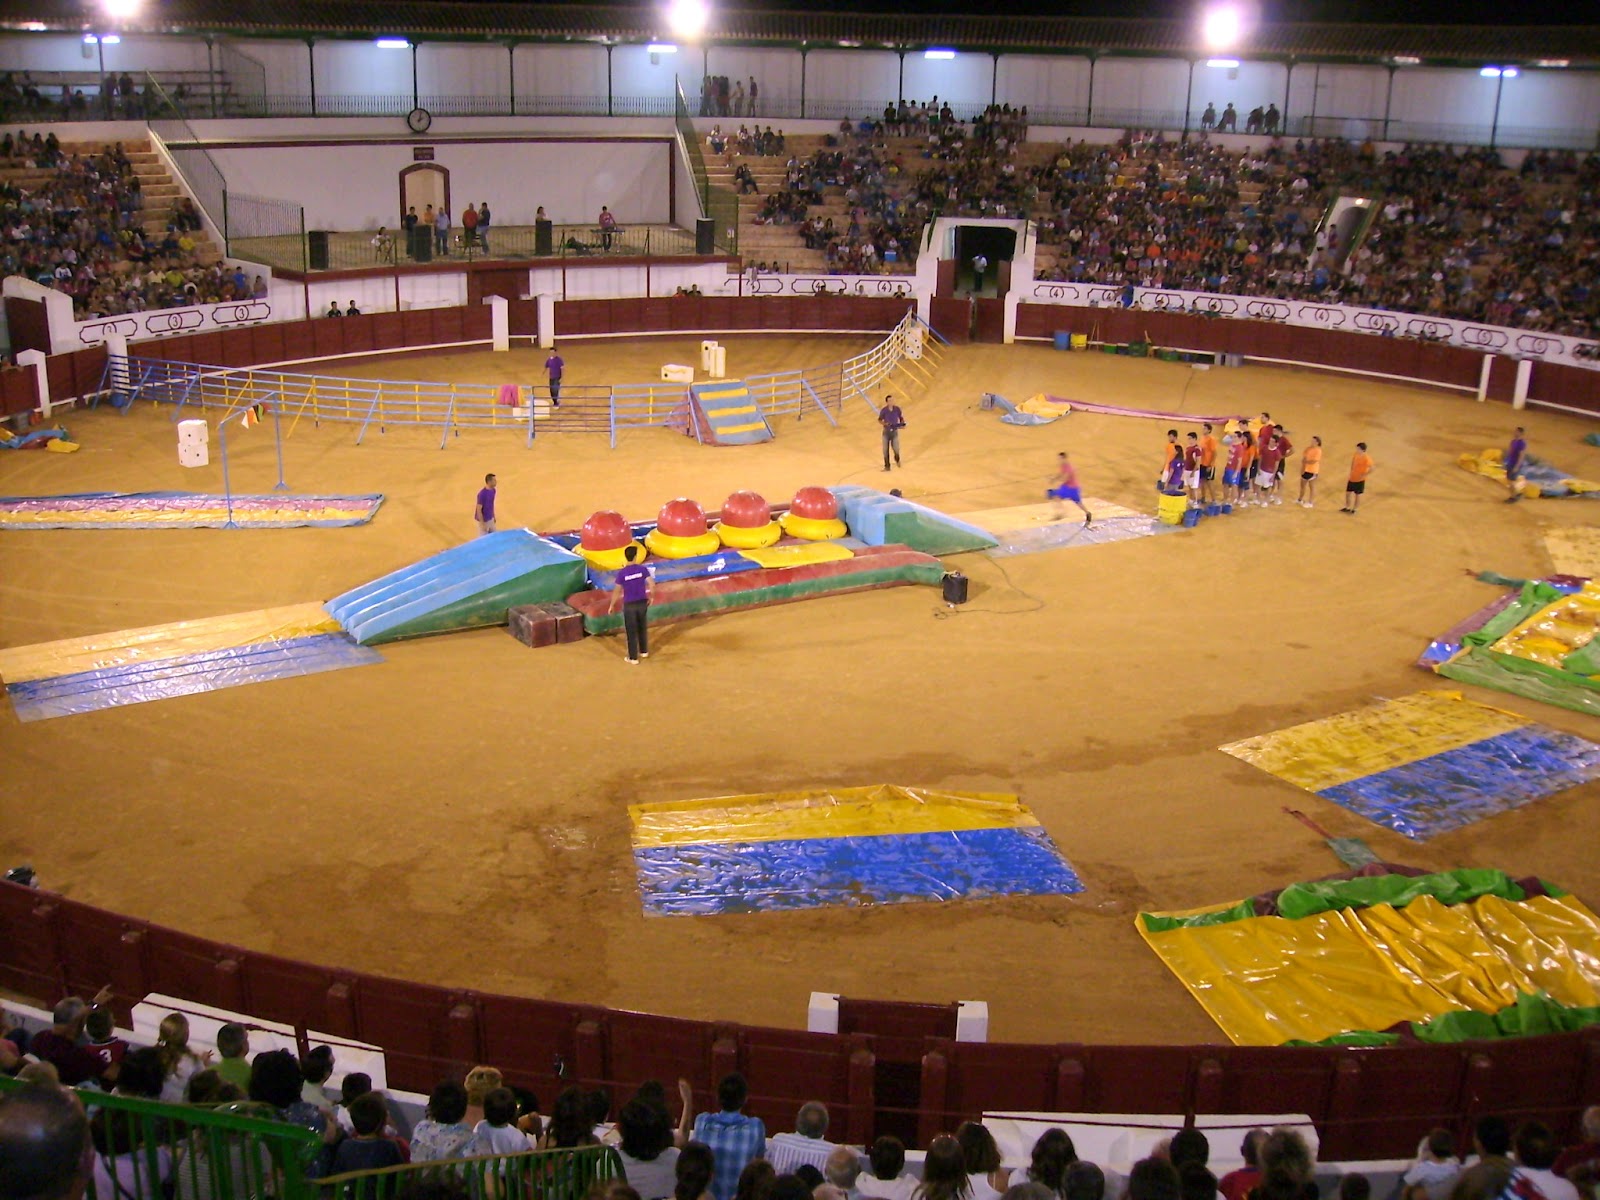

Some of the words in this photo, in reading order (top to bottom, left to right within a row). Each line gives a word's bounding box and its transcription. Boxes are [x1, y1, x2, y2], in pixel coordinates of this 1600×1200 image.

[815, 282, 821, 291] 4
[881, 283, 887, 292] 4
[1053, 289, 1059, 298] 4
[1106, 292, 1112, 301] 4
[239, 308, 245, 319] 3
[1265, 306, 1271, 315] 4
[1319, 311, 1324, 320] 4
[172, 316, 178, 327] 3
[1373, 318, 1379, 327] 4
[99, 1049, 112, 1063] 3
